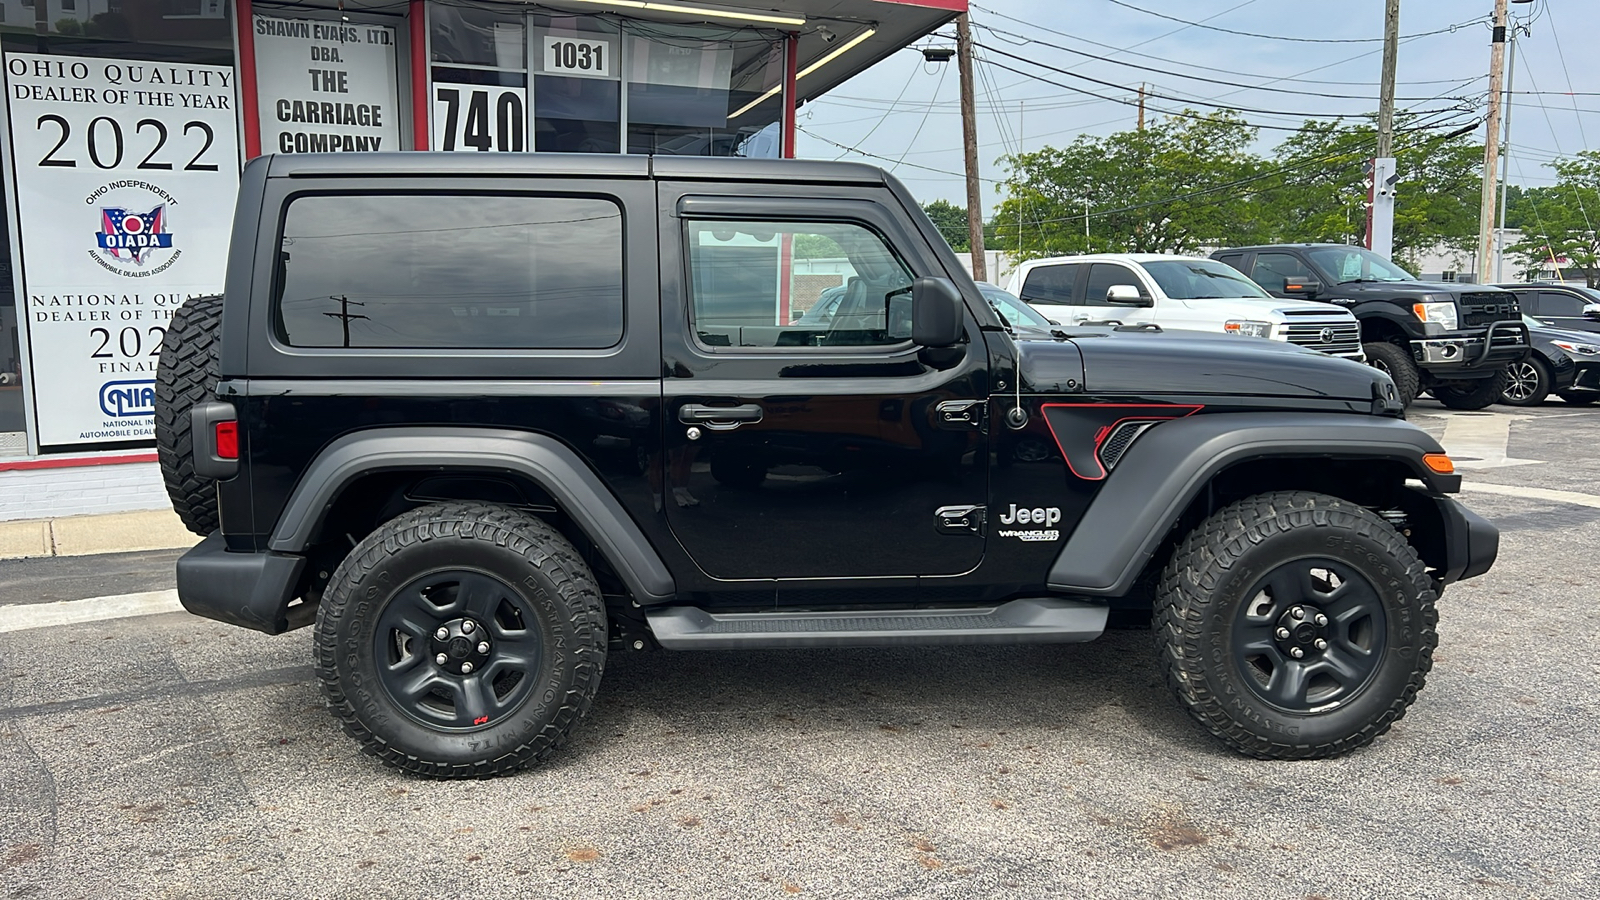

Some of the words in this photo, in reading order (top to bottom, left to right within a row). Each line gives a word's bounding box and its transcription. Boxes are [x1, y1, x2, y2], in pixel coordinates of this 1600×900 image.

[255, 19, 310, 38] SHAWN
[313, 24, 361, 43] EVANS.
[366, 29, 394, 46] LTD.
[310, 45, 344, 63] DBA.
[550, 42, 604, 71] 1031
[8, 58, 89, 80] OHIO
[104, 64, 232, 88] QUALITY
[308, 69, 349, 94] THE
[13, 84, 98, 103] DEALER
[102, 89, 129, 105] OF
[134, 91, 175, 107] THE
[179, 93, 231, 110] YEAR
[276, 98, 383, 127] CARRIAGE
[437, 88, 524, 152] 740
[36, 113, 219, 172] 2022
[278, 131, 382, 154] COMPANY
[85, 185, 108, 205] OHIO
[108, 179, 179, 206] INDEPENDENT
[105, 234, 161, 248] OIADA
[87, 249, 122, 276] AUTOMOBILE
[123, 269, 151, 278] DEALERS
[151, 248, 182, 276] ASSOCIATION
[32, 293, 144, 308] NATIONAL
[36, 310, 112, 322] DEALER
[120, 309, 144, 321] OF
[151, 309, 175, 320] TH
[89, 325, 167, 359] 202
[98, 360, 158, 374] FINAL
[107, 387, 157, 409] NIA
[79, 429, 131, 439] AUTOMOBILE
[133, 428, 156, 436] DEAL
[102, 419, 143, 428] NATIONAL
[999, 503, 1061, 528] Jeep
[998, 529, 1060, 537] WRANGLER
